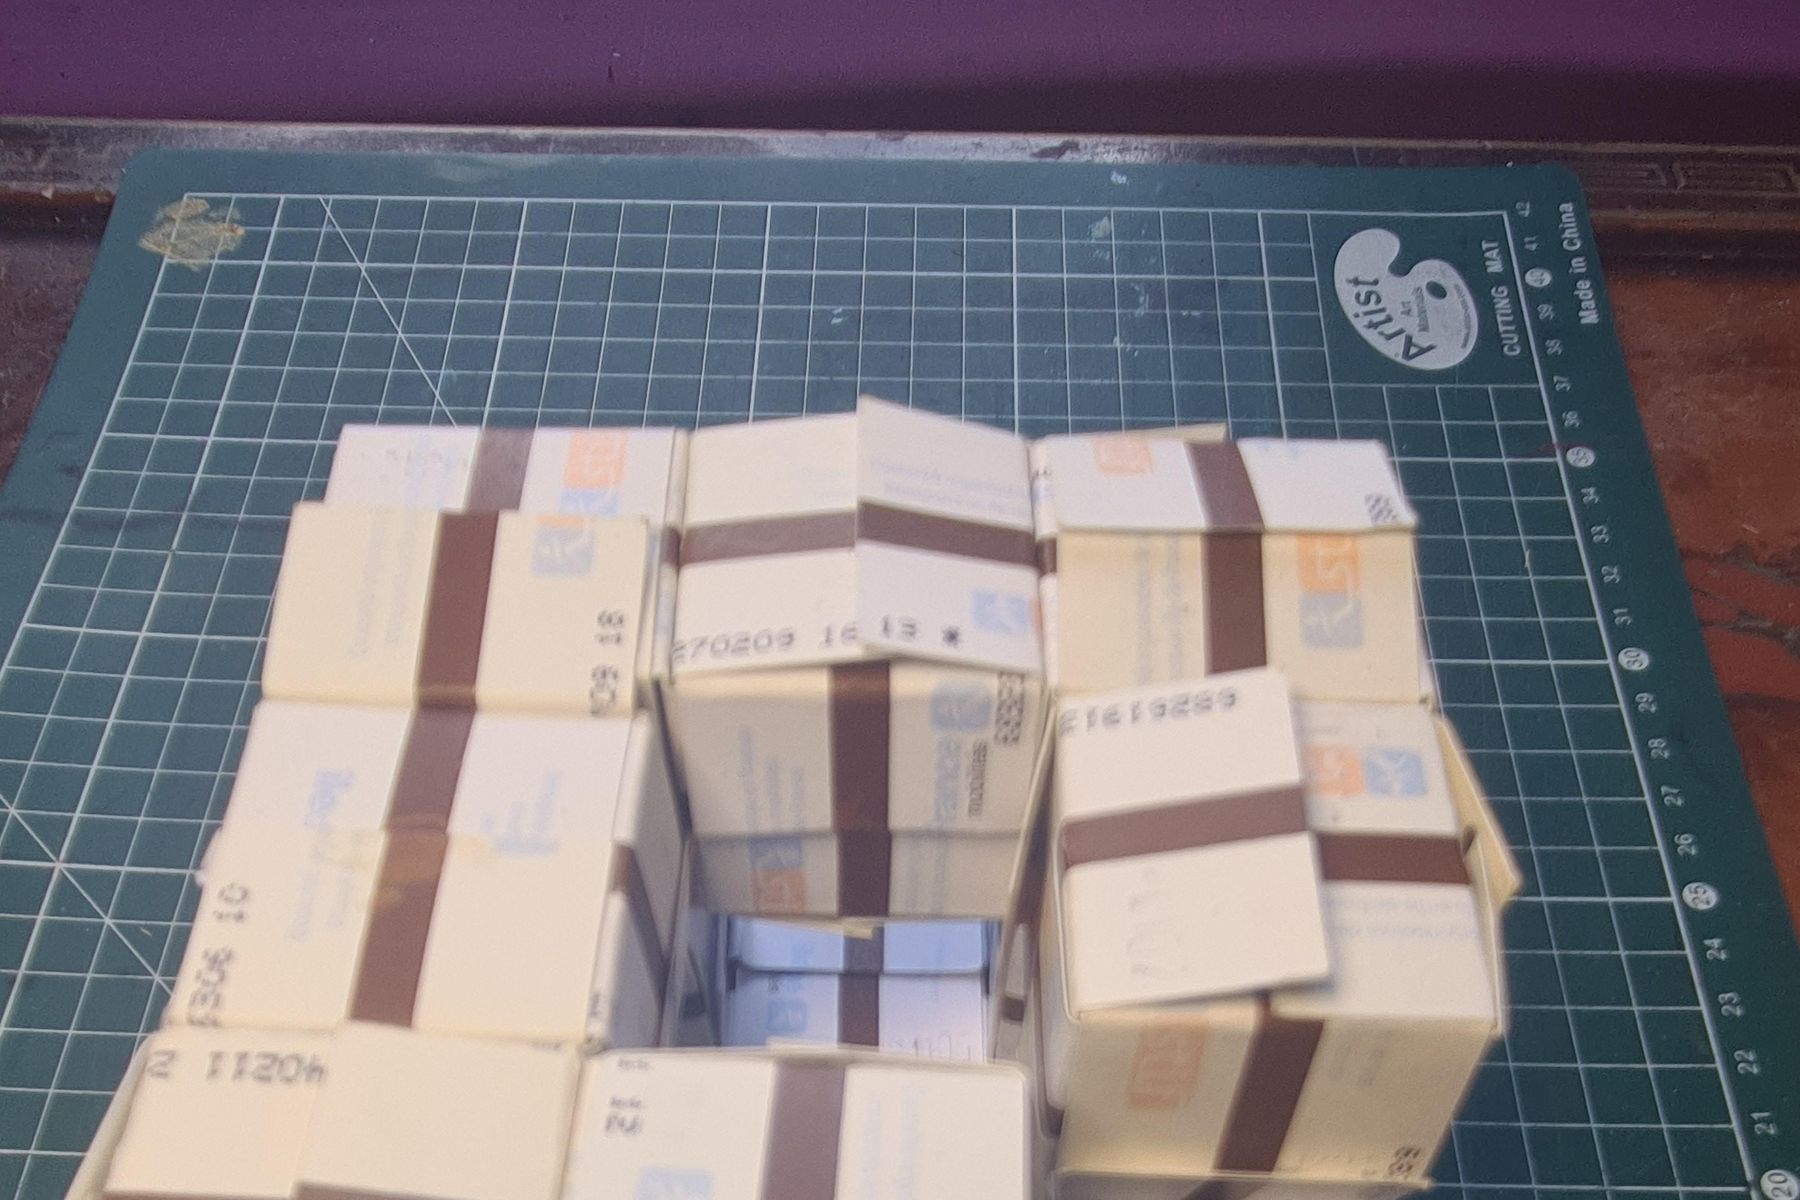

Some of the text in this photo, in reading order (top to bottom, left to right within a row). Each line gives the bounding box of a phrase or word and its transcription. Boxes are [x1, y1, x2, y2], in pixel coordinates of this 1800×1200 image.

[1516, 201, 1530, 217] 42
[1524, 236, 1539, 251] 41
[1559, 201, 1600, 325] Made in China
[1346, 276, 1437, 363] Artist
[1491, 285, 1522, 357] CUTTING
[1538, 304, 1554, 320] 39
[1545, 339, 1562, 355] 38
[1554, 376, 1571, 392] 37
[1564, 410, 1581, 428] 36
[1581, 486, 1600, 505] 34
[1591, 524, 1610, 543] 33
[1601, 565, 1621, 585] 32
[1615, 608, 1633, 626] 31
[1623, 648, 1643, 669] 30
[1637, 692, 1656, 714] 29
[1647, 738, 1671, 760] 28
[1661, 785, 1685, 807] 27
[1675, 834, 1699, 856] 26
[1690, 883, 1712, 906] 25
[1705, 937, 1728, 962] 24
[1719, 991, 1745, 1017] 23
[1734, 1049, 1759, 1075] 22
[1751, 1111, 1777, 1136] 21
[1766, 1172, 1793, 1198] 20
